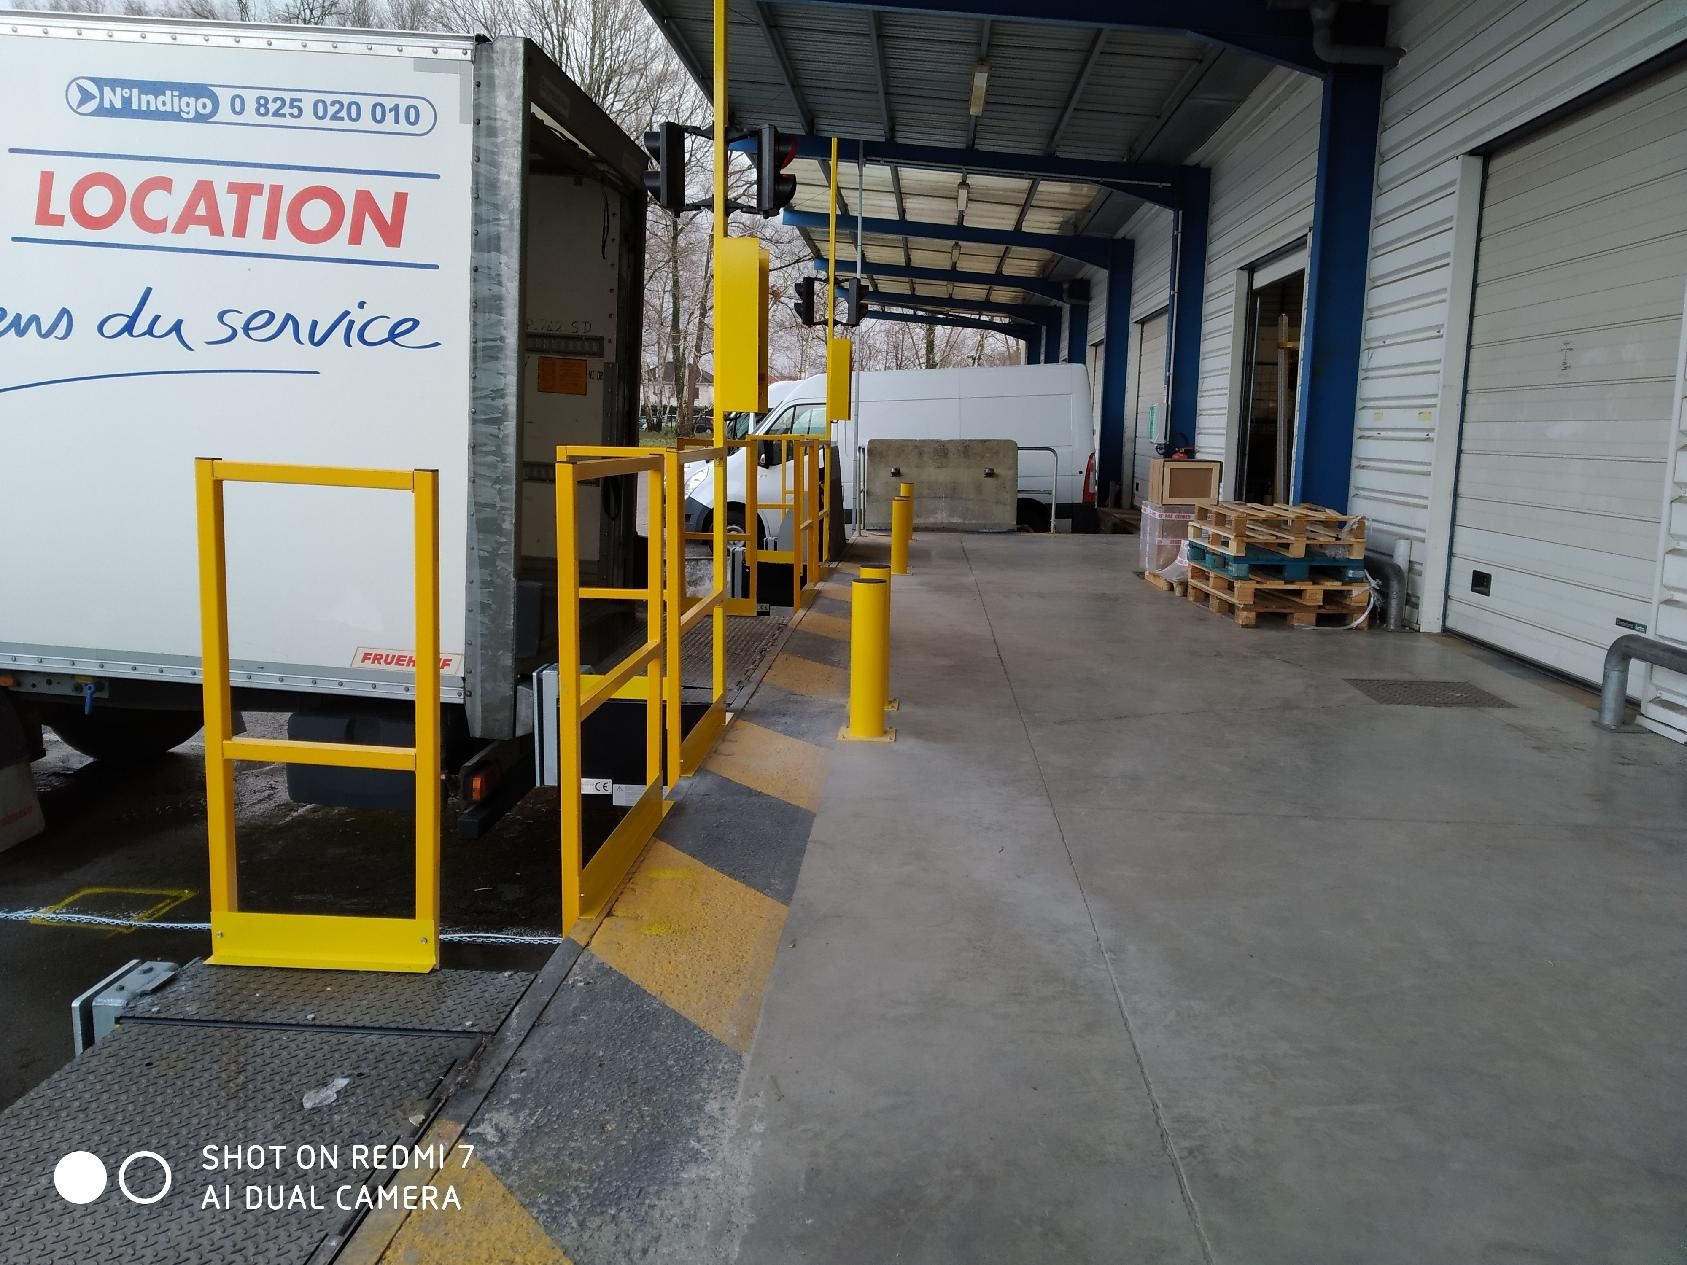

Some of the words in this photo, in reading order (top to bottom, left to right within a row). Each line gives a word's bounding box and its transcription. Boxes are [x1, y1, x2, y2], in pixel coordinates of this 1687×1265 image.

[229, 94, 246, 117] 0
[254, 96, 304, 119] 825
[312, 99, 362, 123] 020
[371, 102, 420, 126] 010
[34, 170, 409, 249] LOCATION
[96, 287, 194, 352] du
[204, 300, 441, 350] service
